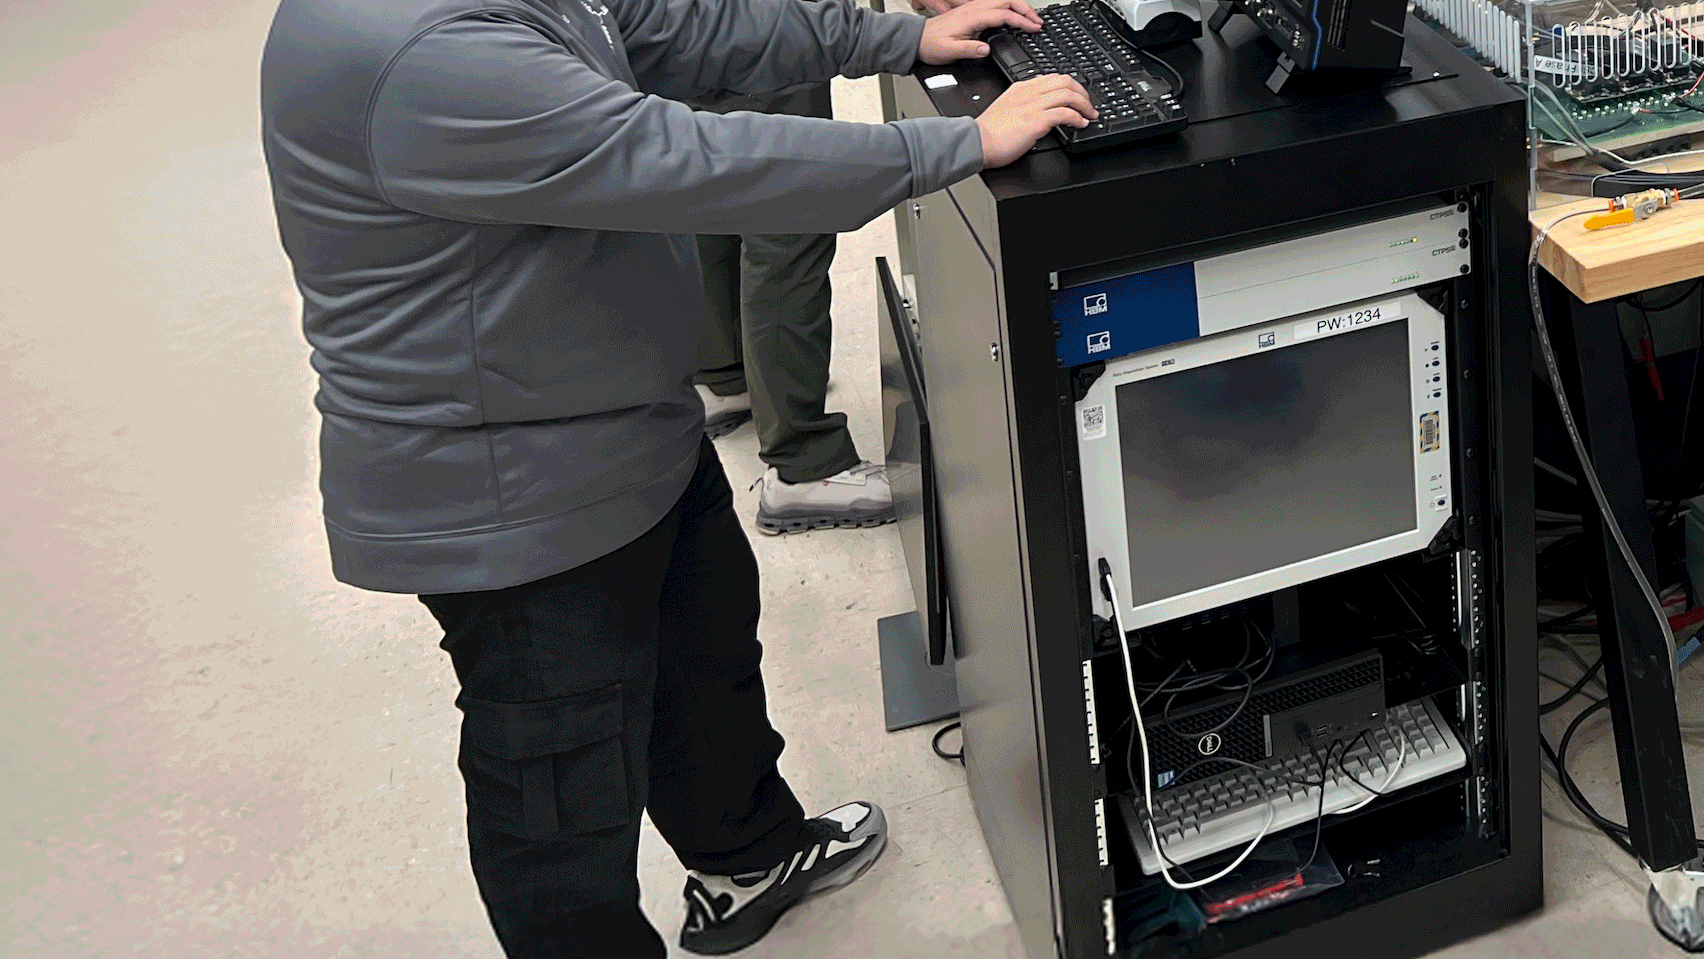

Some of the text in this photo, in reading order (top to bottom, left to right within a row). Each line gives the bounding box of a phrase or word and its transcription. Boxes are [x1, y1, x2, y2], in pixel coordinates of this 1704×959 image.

[1085, 305, 1108, 317] HBM
[1317, 307, 1382, 334] PW:1234
[1088, 342, 1111, 355] HBM
